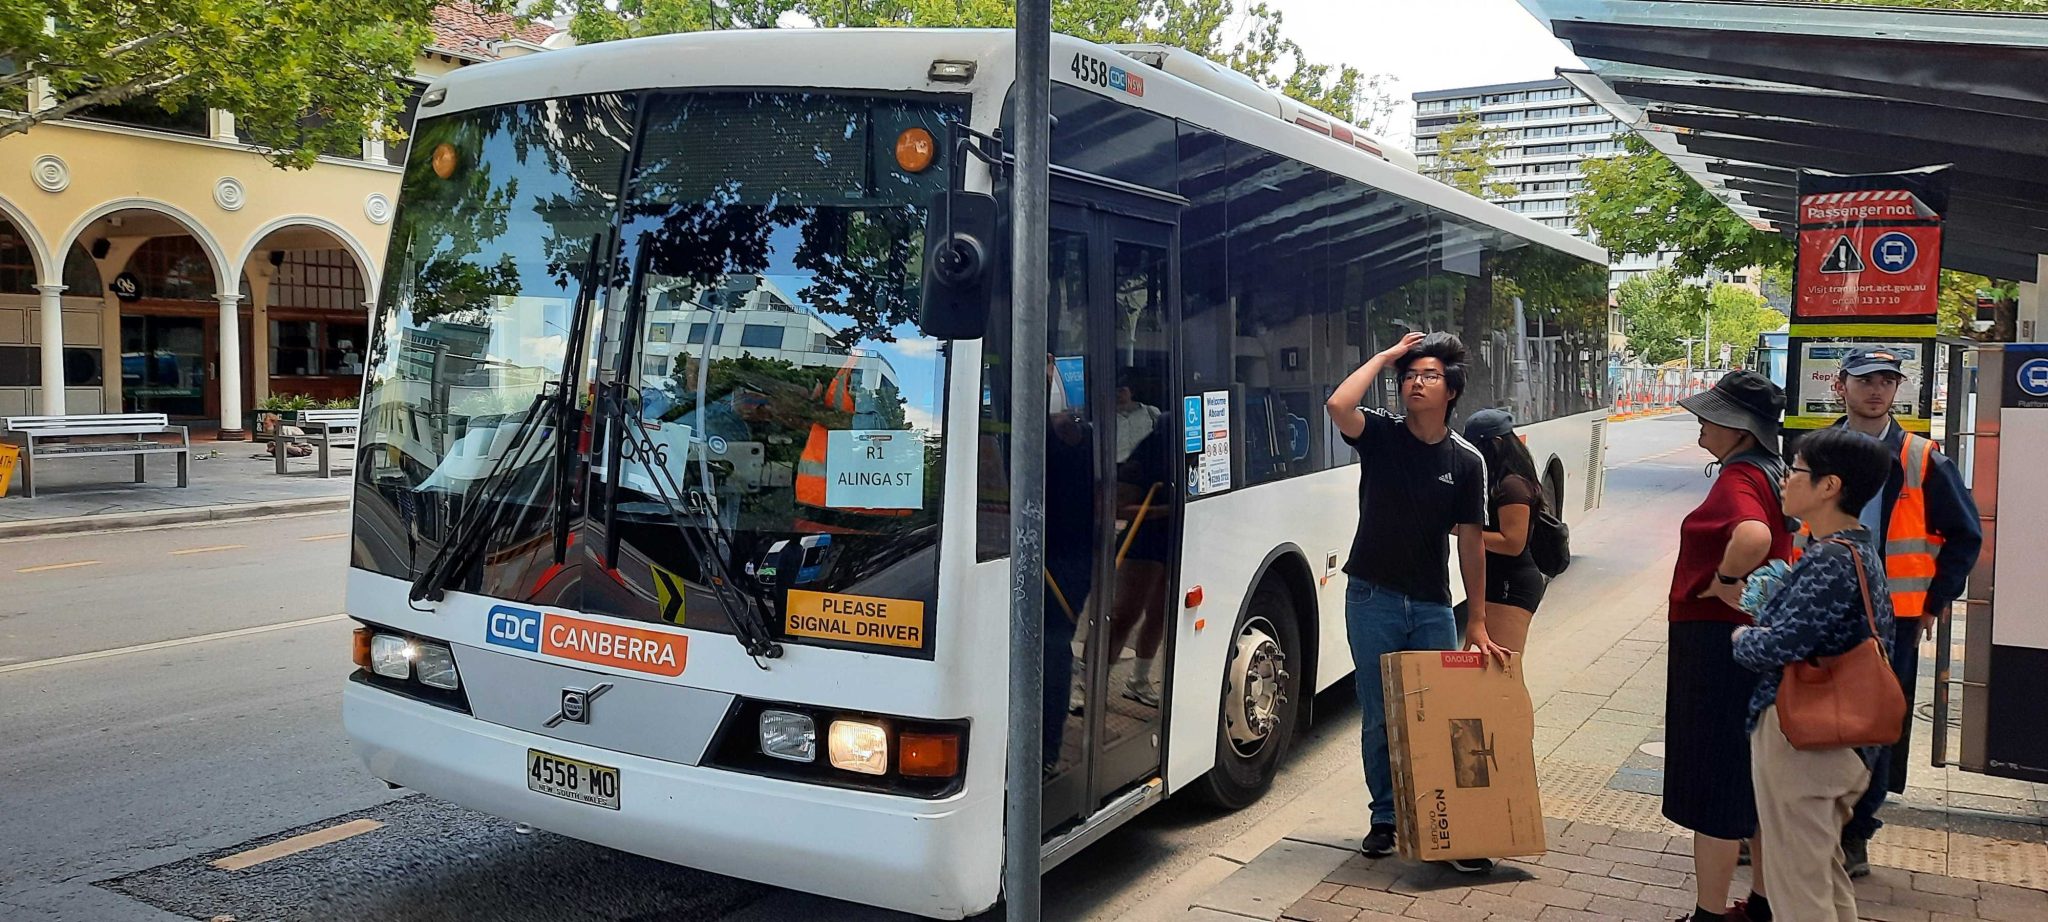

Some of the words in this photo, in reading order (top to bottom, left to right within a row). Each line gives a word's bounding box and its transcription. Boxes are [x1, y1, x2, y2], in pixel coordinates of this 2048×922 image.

[1071, 52, 1107, 88] 4558
[1110, 70, 1125, 87] CDC
[1127, 76, 1143, 93] NSW
[1807, 205, 1883, 219] Passenger
[1886, 204, 1915, 215] not
[1808, 286, 1828, 295] Visit
[1862, 296, 1873, 304] 13
[1875, 296, 1887, 304] 17
[1888, 296, 1900, 304] 10
[620, 436, 669, 467] QR6
[866, 446, 885, 460] R1
[838, 472, 892, 486] ALINGA
[895, 472, 913, 487] ST
[822, 598, 888, 619] PLEASE
[789, 614, 851, 635] SIGNAL
[856, 621, 919, 642] DRIVER
[490, 612, 537, 645] CDC
[549, 623, 677, 668] CANBERRA
[1444, 655, 1480, 665] Lenovo
[538, 784, 553, 793] NEW
[556, 788, 580, 800] SOUTH
[583, 795, 608, 806] WALES
[1434, 788, 1450, 850] LEGION
[1430, 810, 1439, 850] Lenovo
